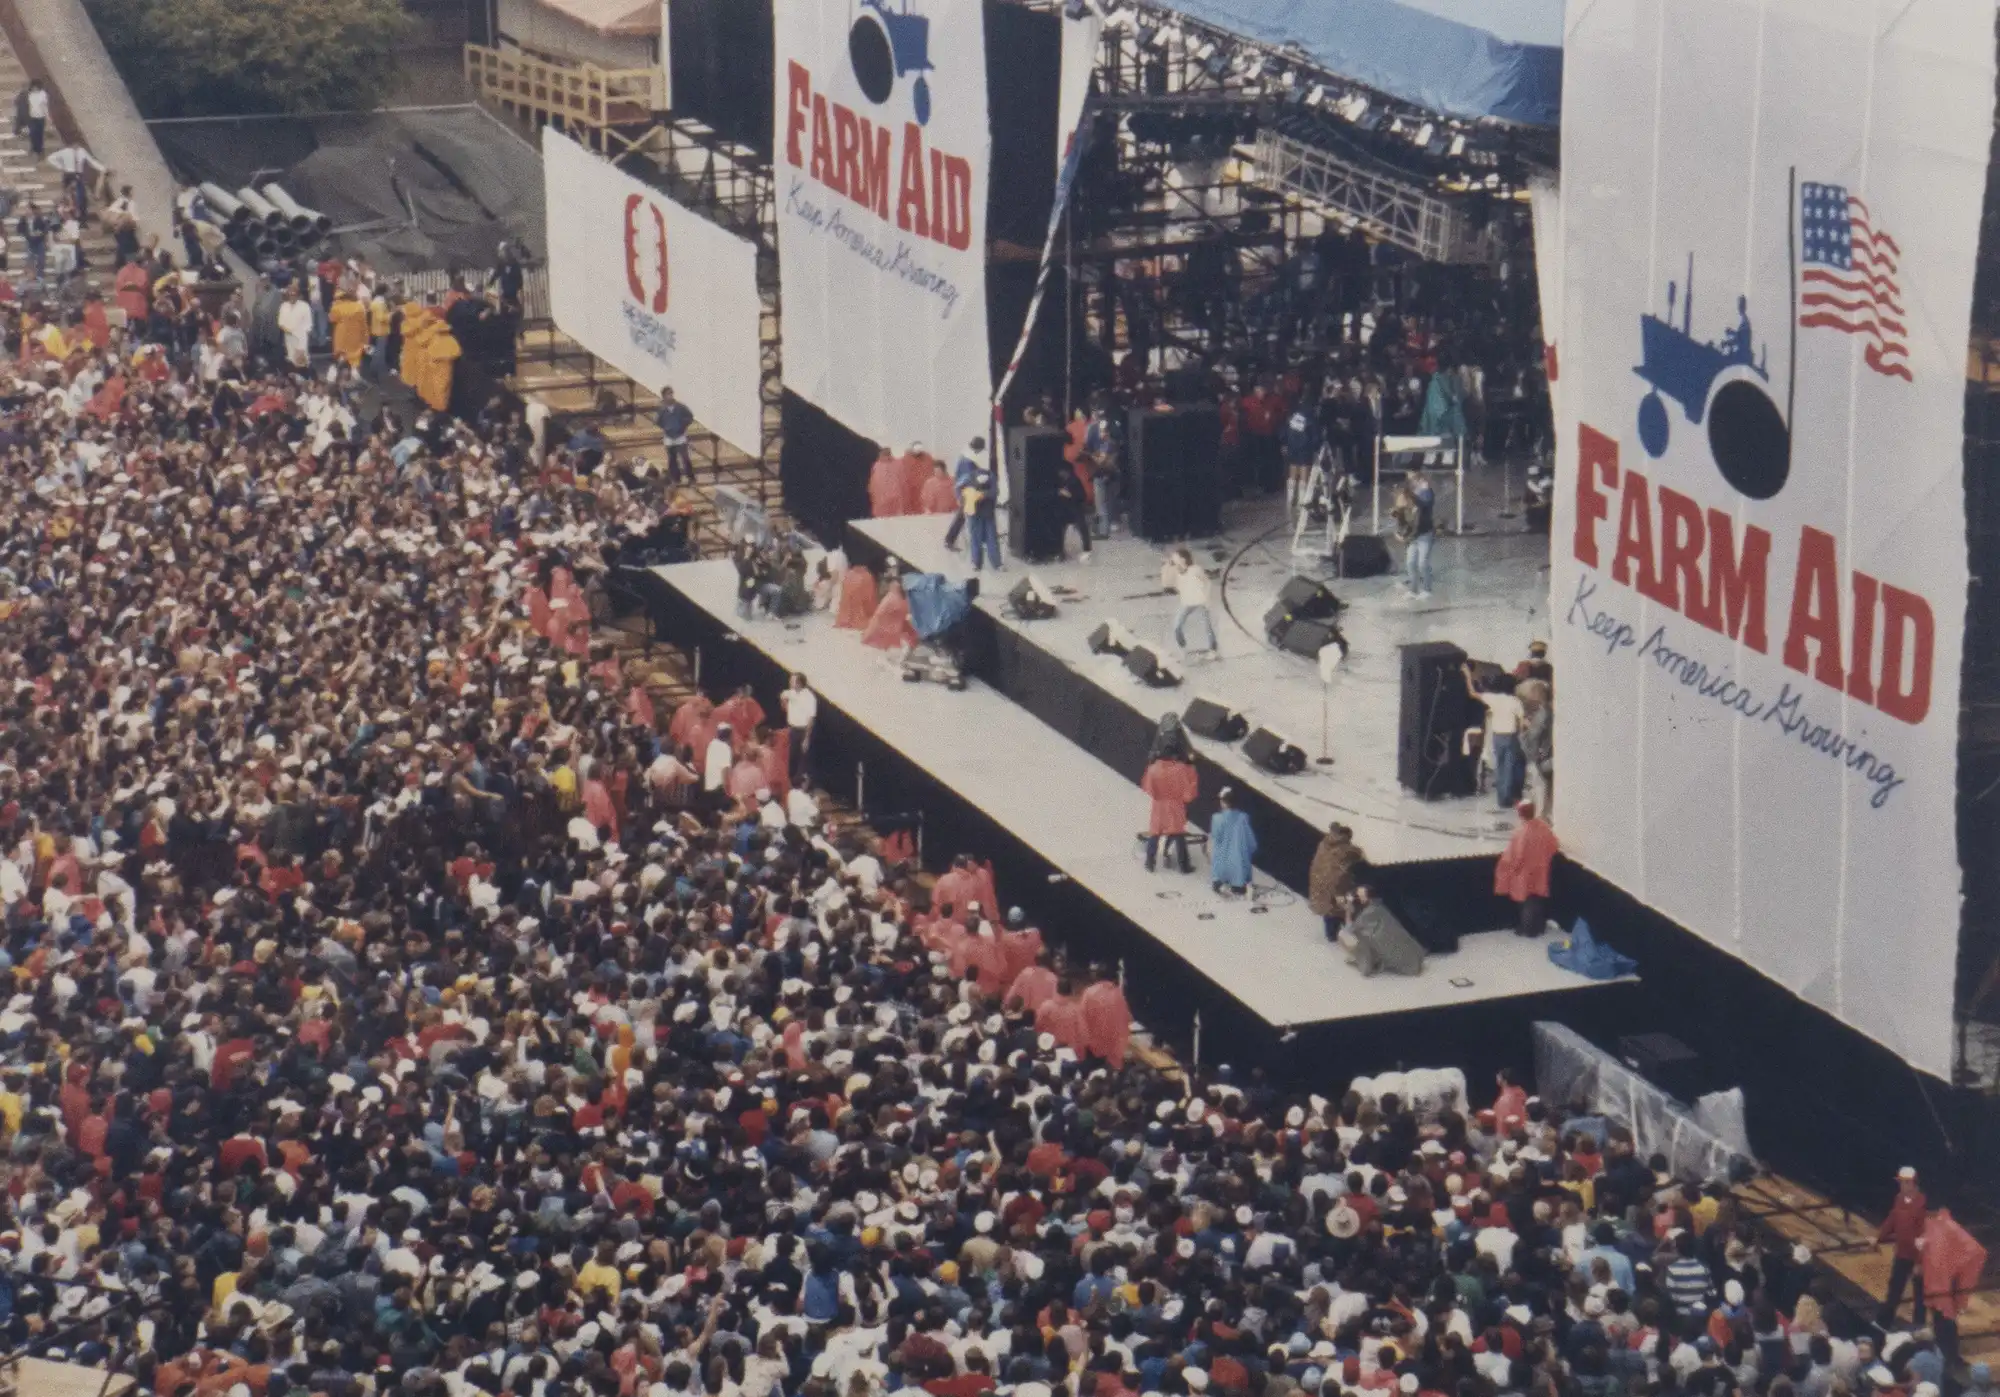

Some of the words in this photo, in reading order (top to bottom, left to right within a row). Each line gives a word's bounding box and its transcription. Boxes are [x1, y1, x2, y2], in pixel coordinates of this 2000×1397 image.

[786, 57, 891, 221] FARM
[896, 121, 971, 251] AID
[1567, 573, 1636, 656] Keep
[1638, 624, 1764, 717] America
[1763, 683, 1905, 809] Growing
[1574, 421, 1772, 655] FARM
[1783, 524, 1935, 725] AID
